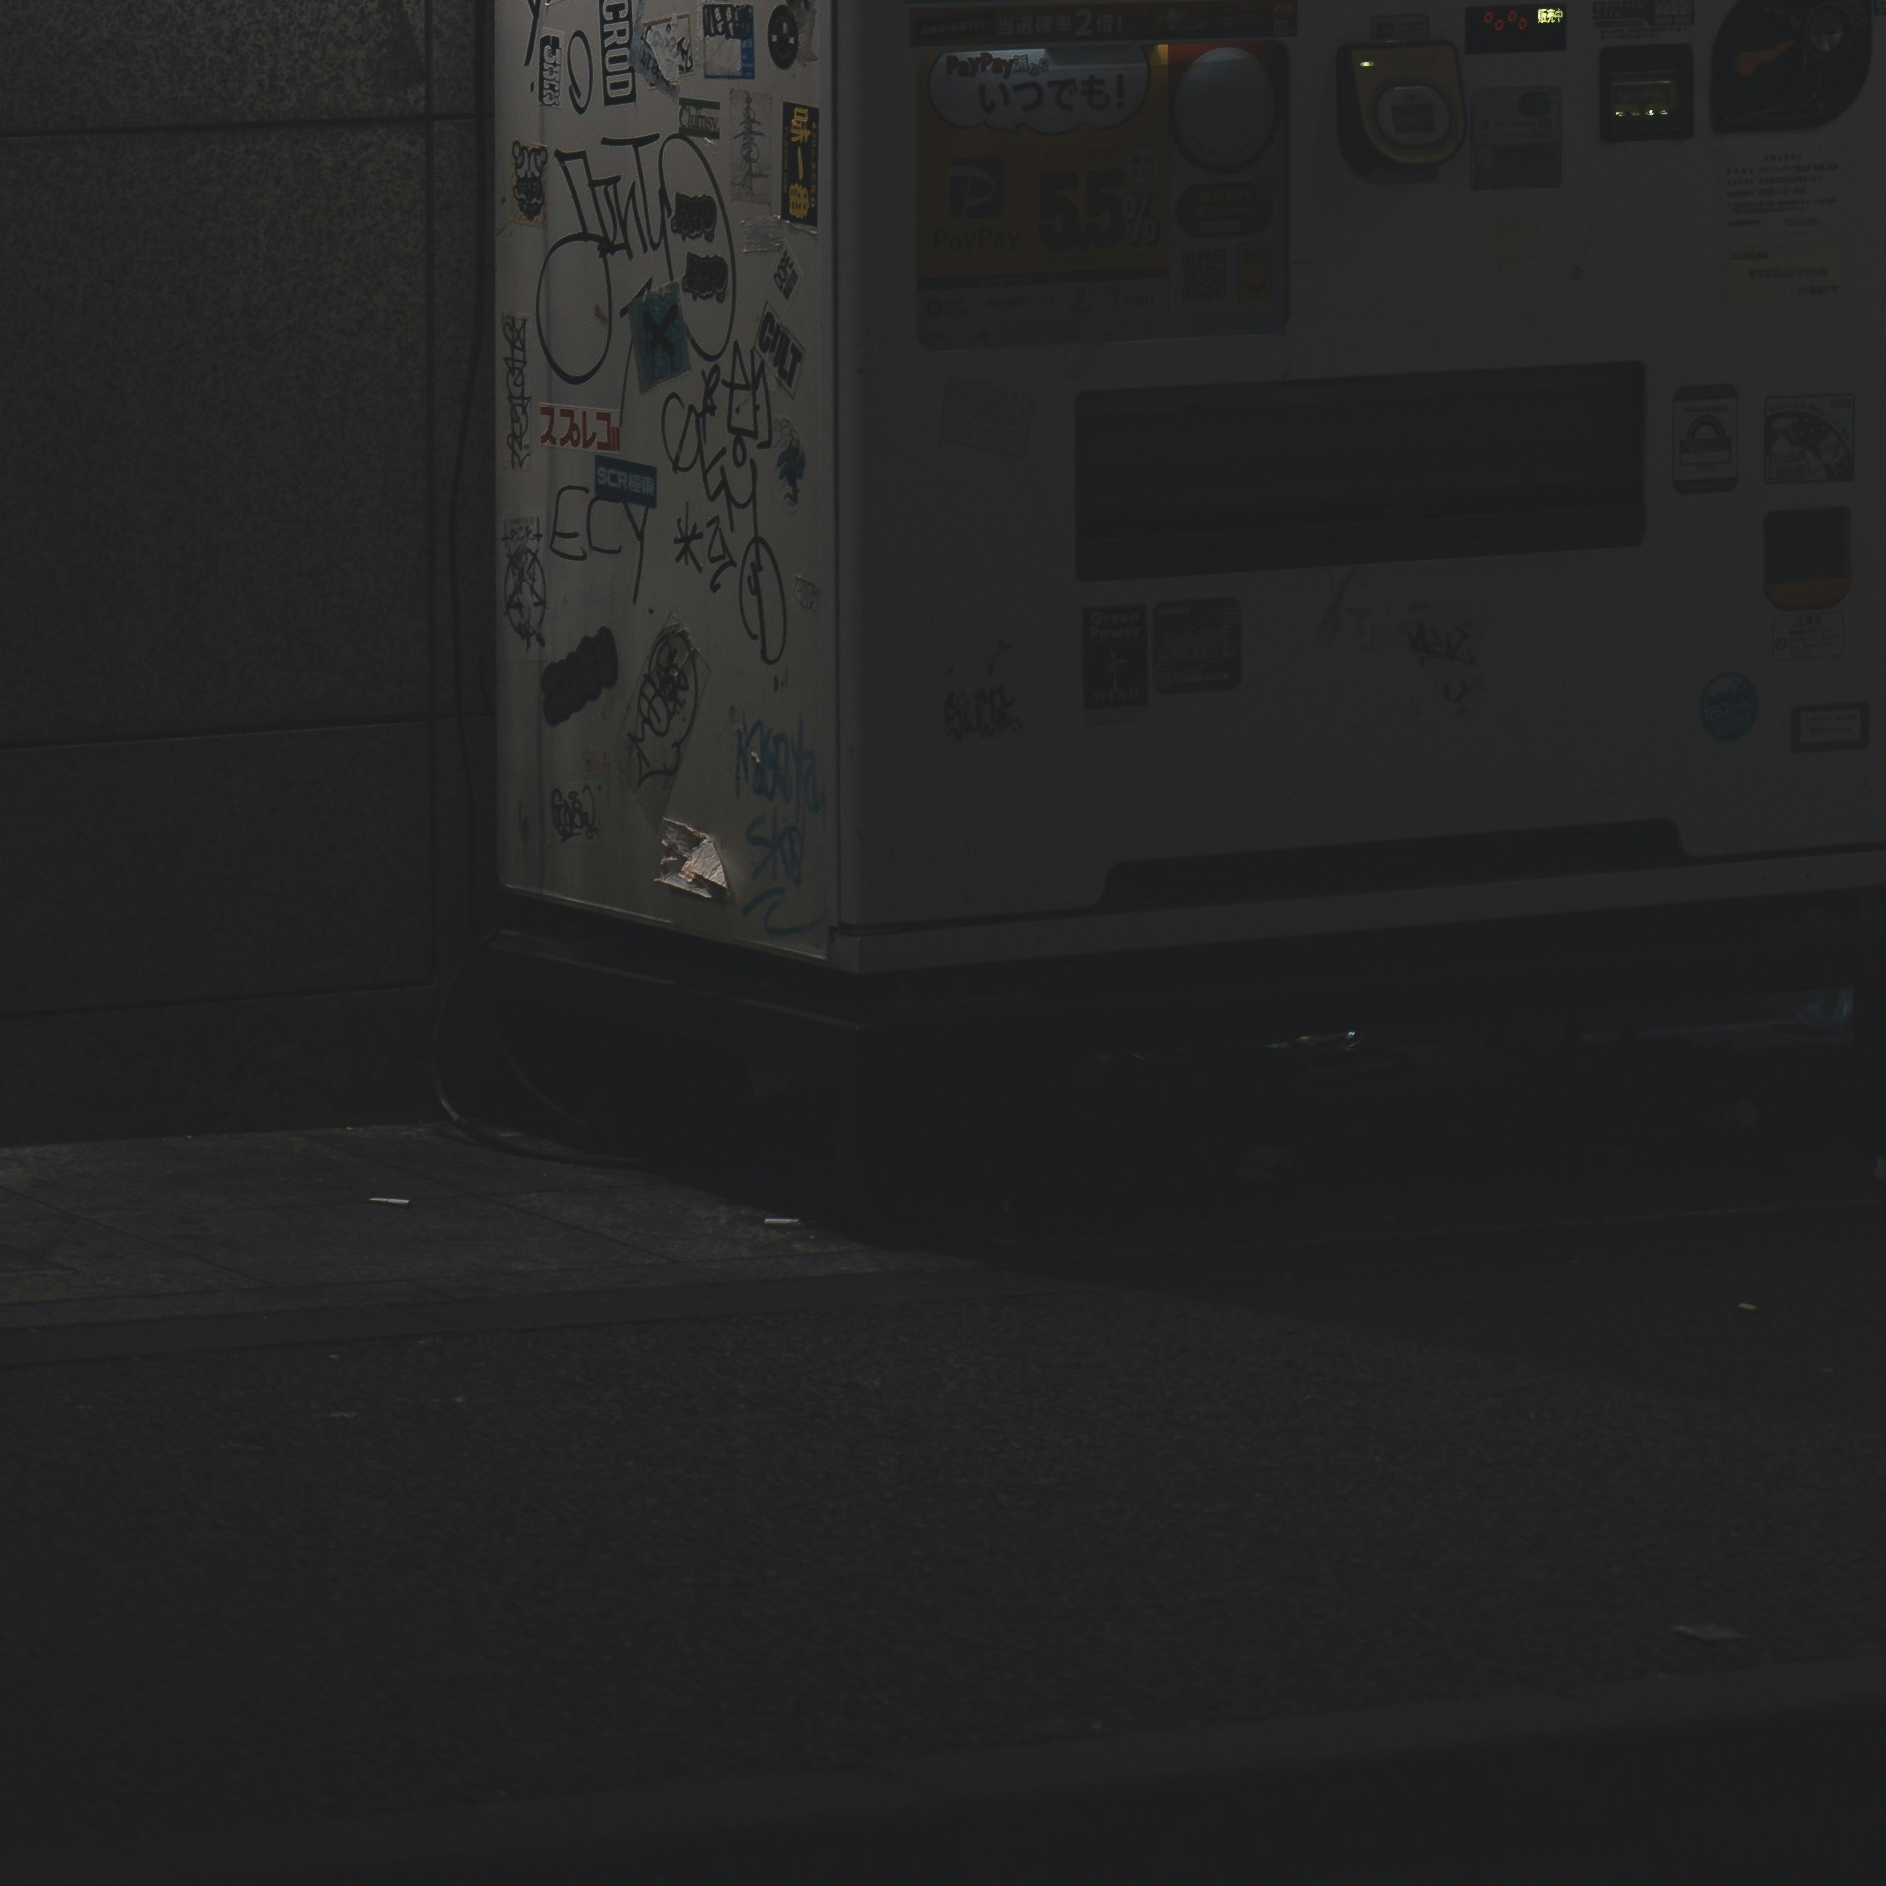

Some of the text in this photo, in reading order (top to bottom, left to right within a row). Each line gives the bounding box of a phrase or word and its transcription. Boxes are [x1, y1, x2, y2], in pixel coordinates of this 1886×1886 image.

[978, 74, 1125, 114] いつでも!
[933, 226, 1021, 255] PayPay
[1088, 610, 1140, 626] Green
